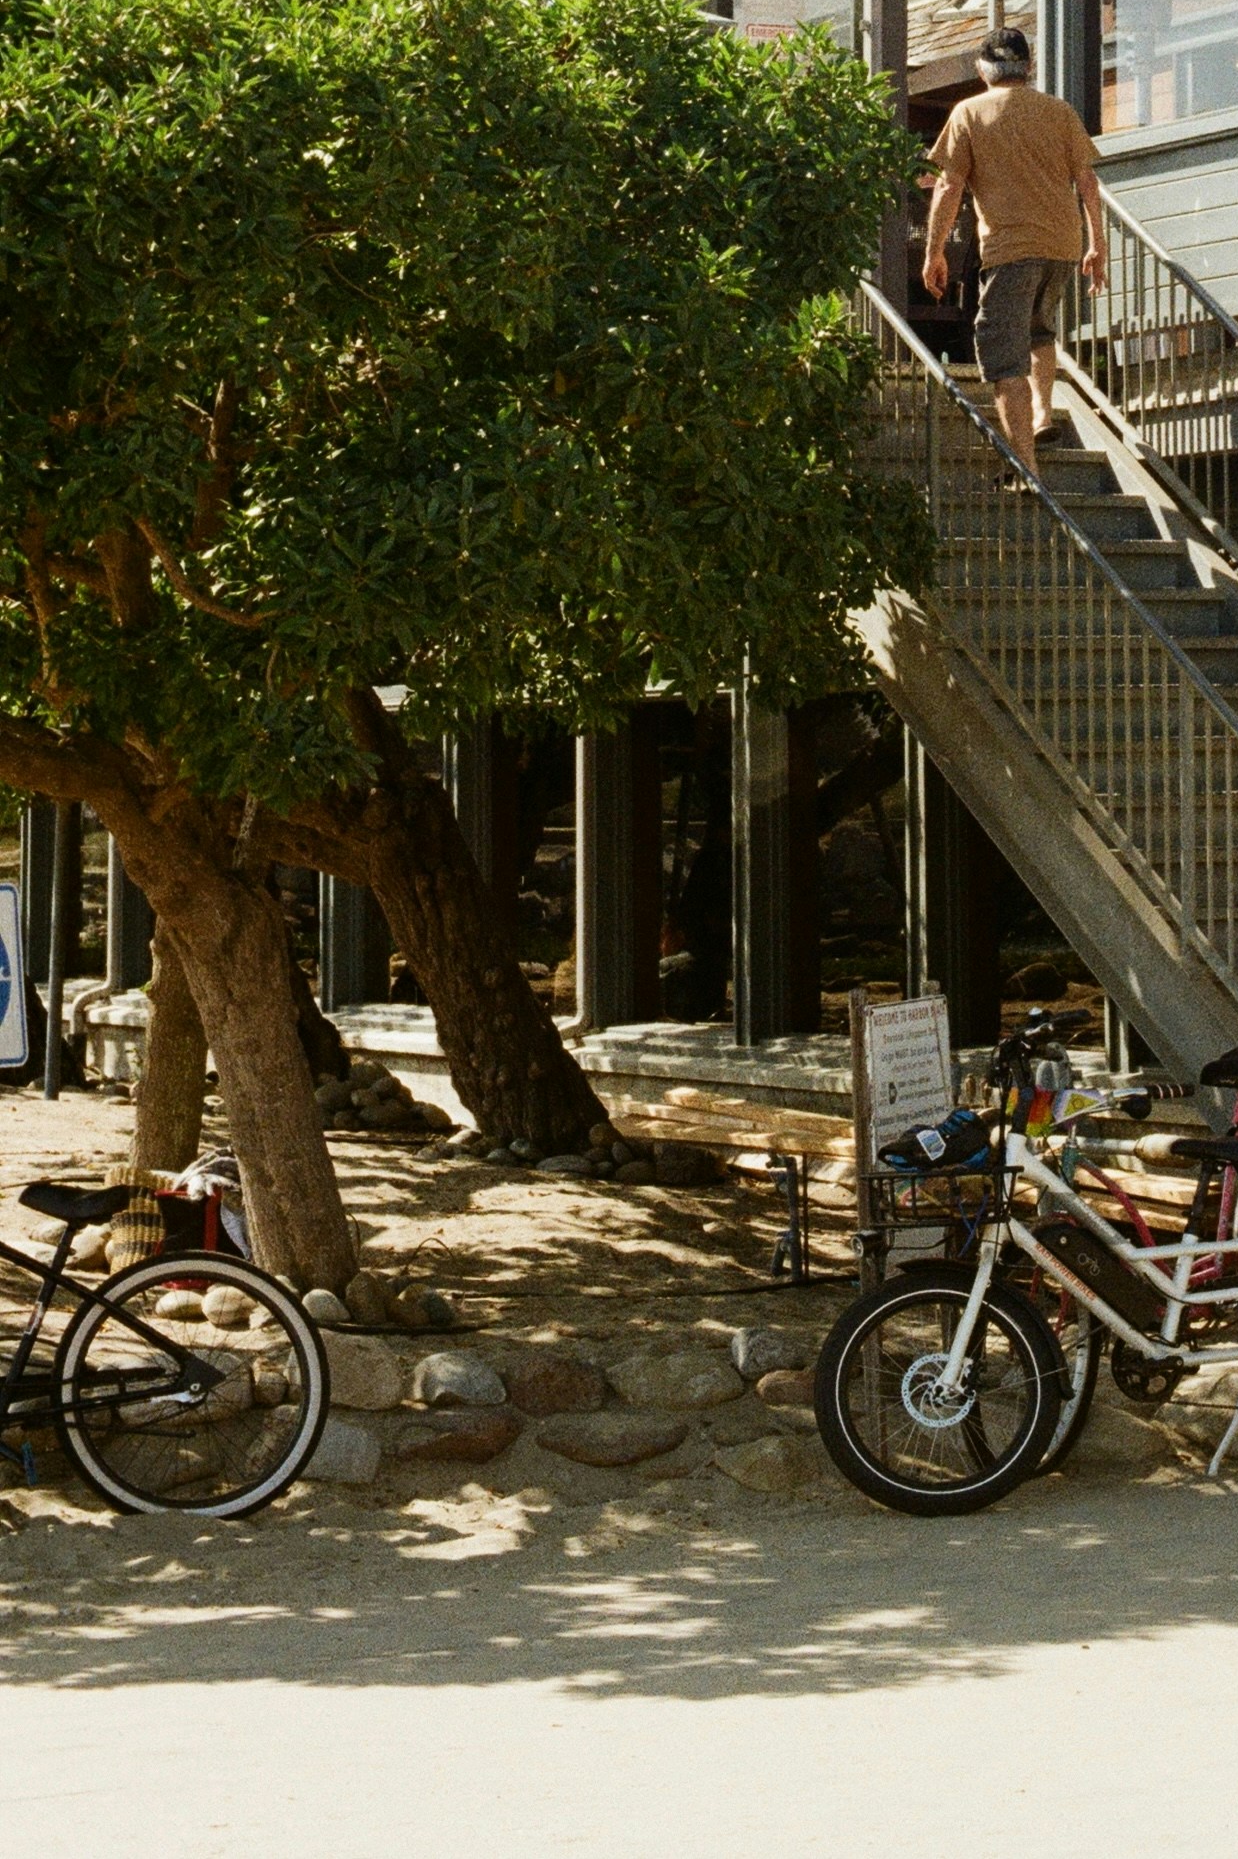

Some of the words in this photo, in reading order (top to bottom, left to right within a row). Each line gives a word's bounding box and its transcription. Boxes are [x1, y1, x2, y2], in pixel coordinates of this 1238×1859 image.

[1035, 1243, 1051, 1258] RAD
[1050, 1257, 1077, 1282] POWER
[1074, 1281, 1096, 1301] BIKES
